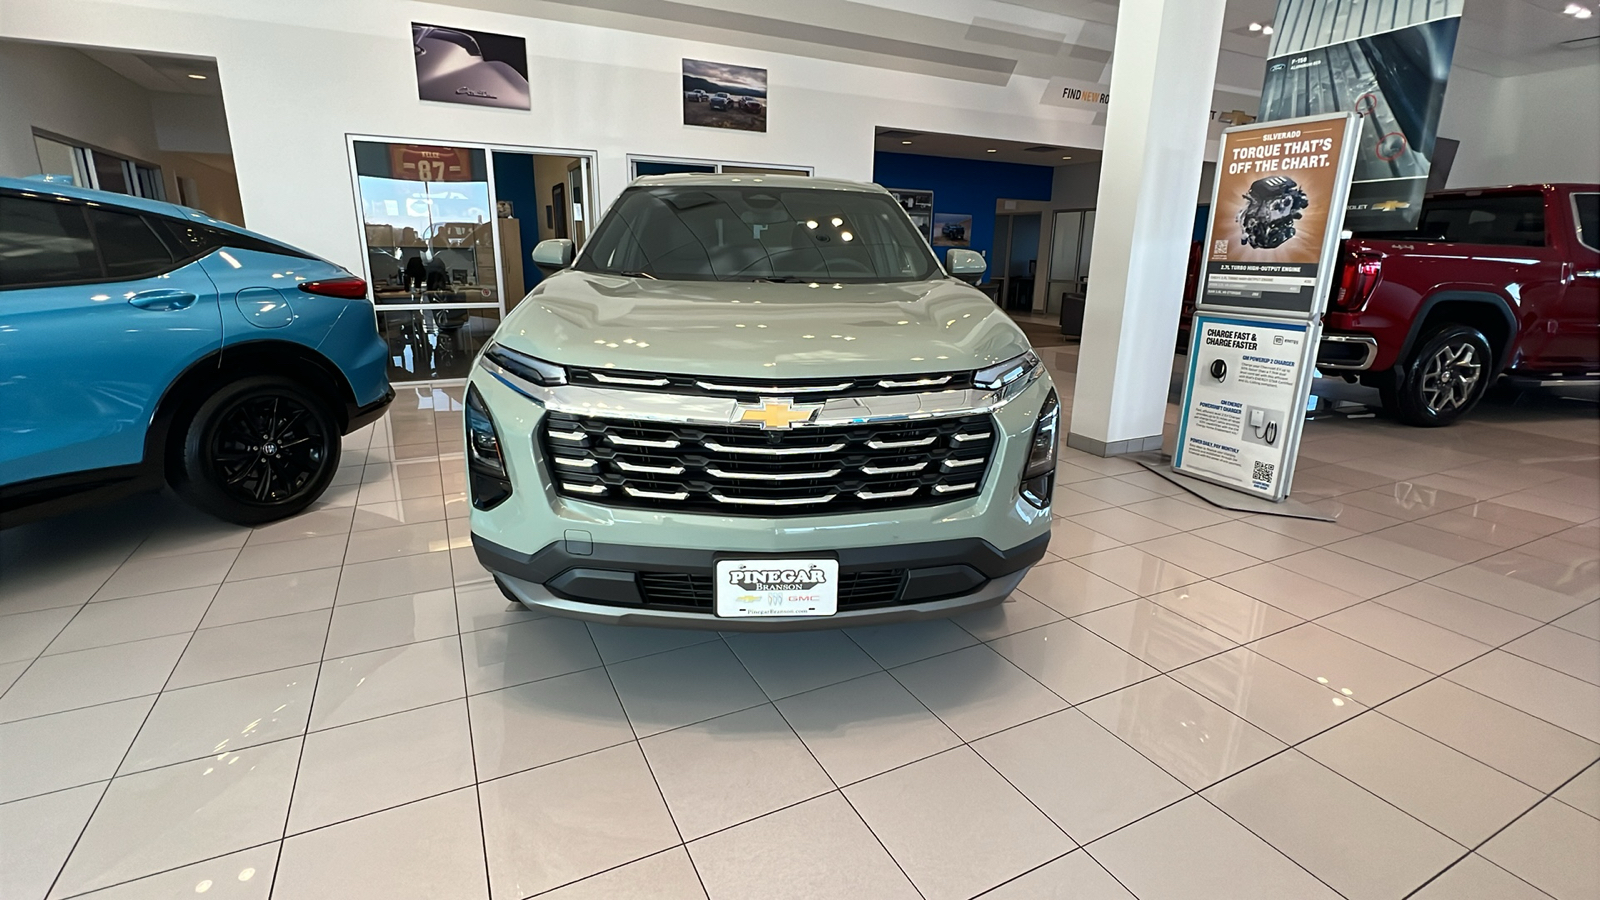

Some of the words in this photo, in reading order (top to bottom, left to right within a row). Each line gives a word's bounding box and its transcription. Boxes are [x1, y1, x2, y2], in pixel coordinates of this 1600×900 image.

[1062, 87, 1082, 100] FIND
[1081, 90, 1100, 103] NEW
[1262, 130, 1301, 141] SILVERADO
[1232, 143, 1281, 160] TORQUE
[1283, 138, 1333, 155] THAT'S
[417, 160, 445, 182] 87
[1228, 161, 1252, 175] OFF
[1254, 159, 1278, 172] THE
[1281, 154, 1330, 170] CHART.
[1207, 329, 1233, 339] CHARGE
[1233, 332, 1251, 341] FAST
[1251, 334, 1257, 342] &
[1206, 338, 1232, 347] CHARGE
[1232, 341, 1258, 351] FASTER
[729, 569, 827, 584] PINEGAR
